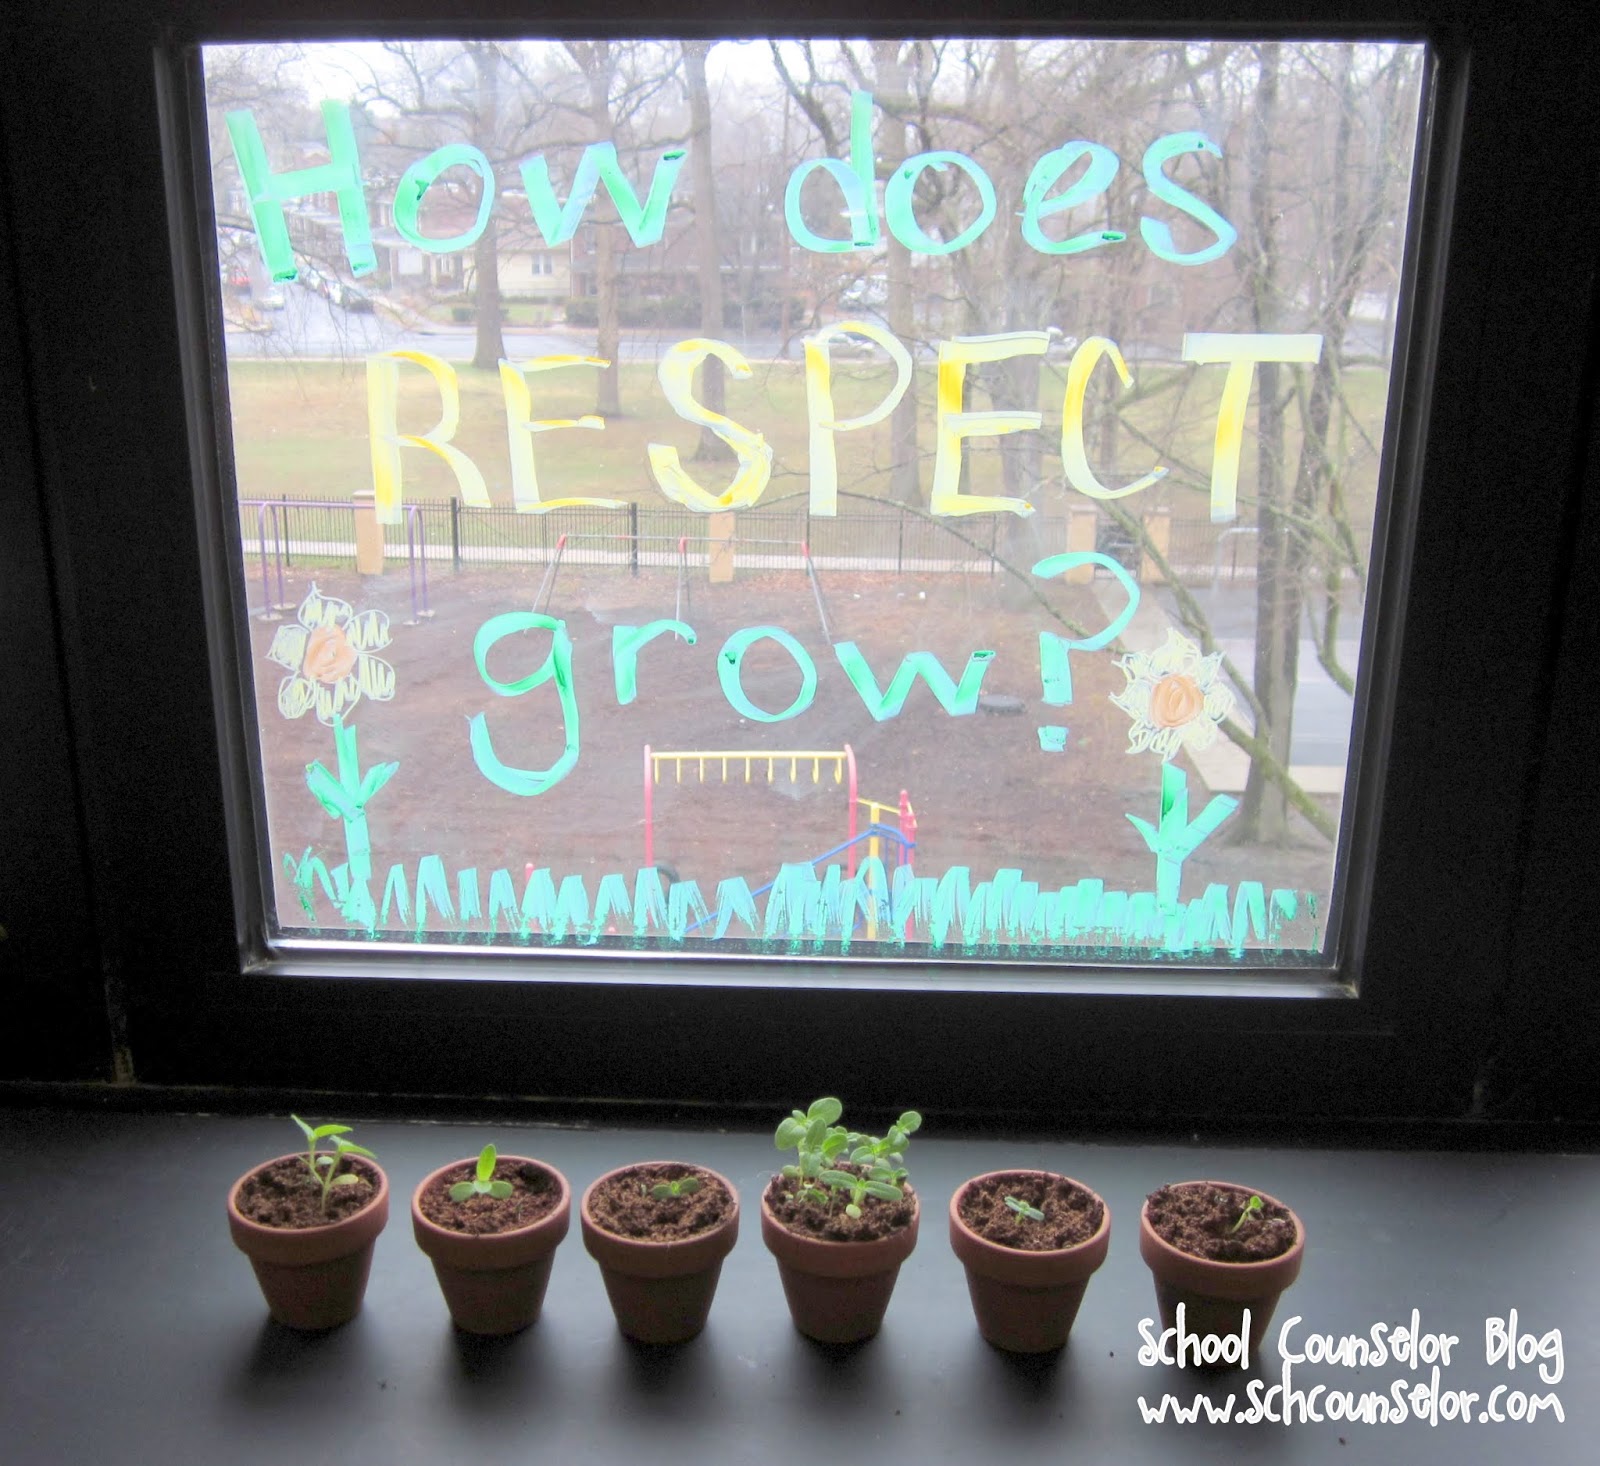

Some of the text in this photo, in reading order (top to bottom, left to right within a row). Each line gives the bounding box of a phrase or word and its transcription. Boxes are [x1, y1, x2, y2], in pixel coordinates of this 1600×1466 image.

[225, 89, 1238, 282] How does
[366, 320, 1324, 525] RESPECT
[465, 551, 1141, 796] grow?
